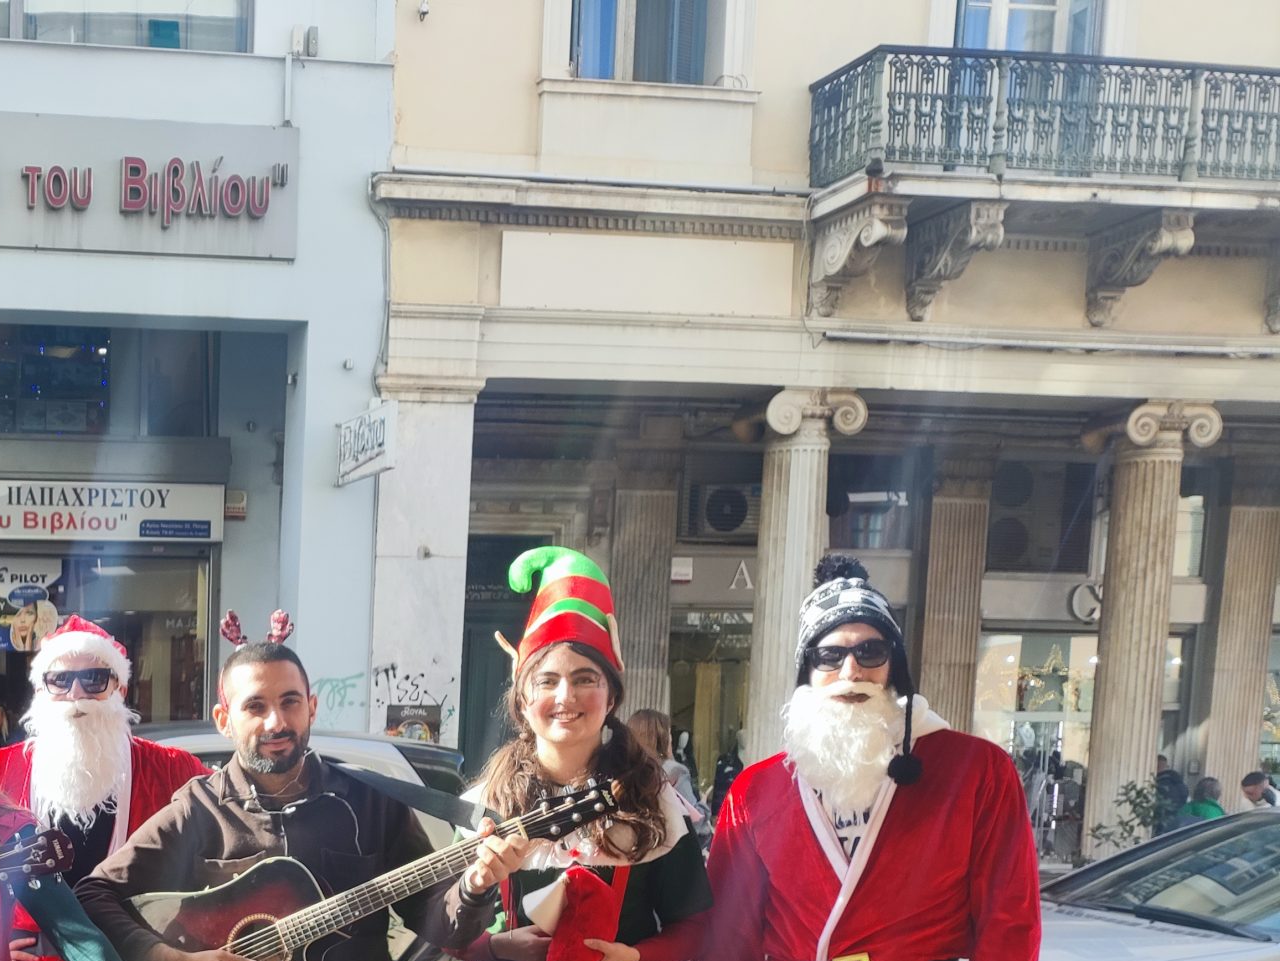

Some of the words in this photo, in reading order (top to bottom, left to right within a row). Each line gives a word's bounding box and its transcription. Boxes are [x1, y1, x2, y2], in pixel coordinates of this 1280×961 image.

[22, 164, 95, 211] του
[120, 155, 289, 229] Βιβλίου"
[7, 486, 171, 509] ΠΑΠΑΧΡΙΣΤΟΥ
[23, 511, 128, 534] Βιβλίου"
[10, 573, 48, 584] PILOT
